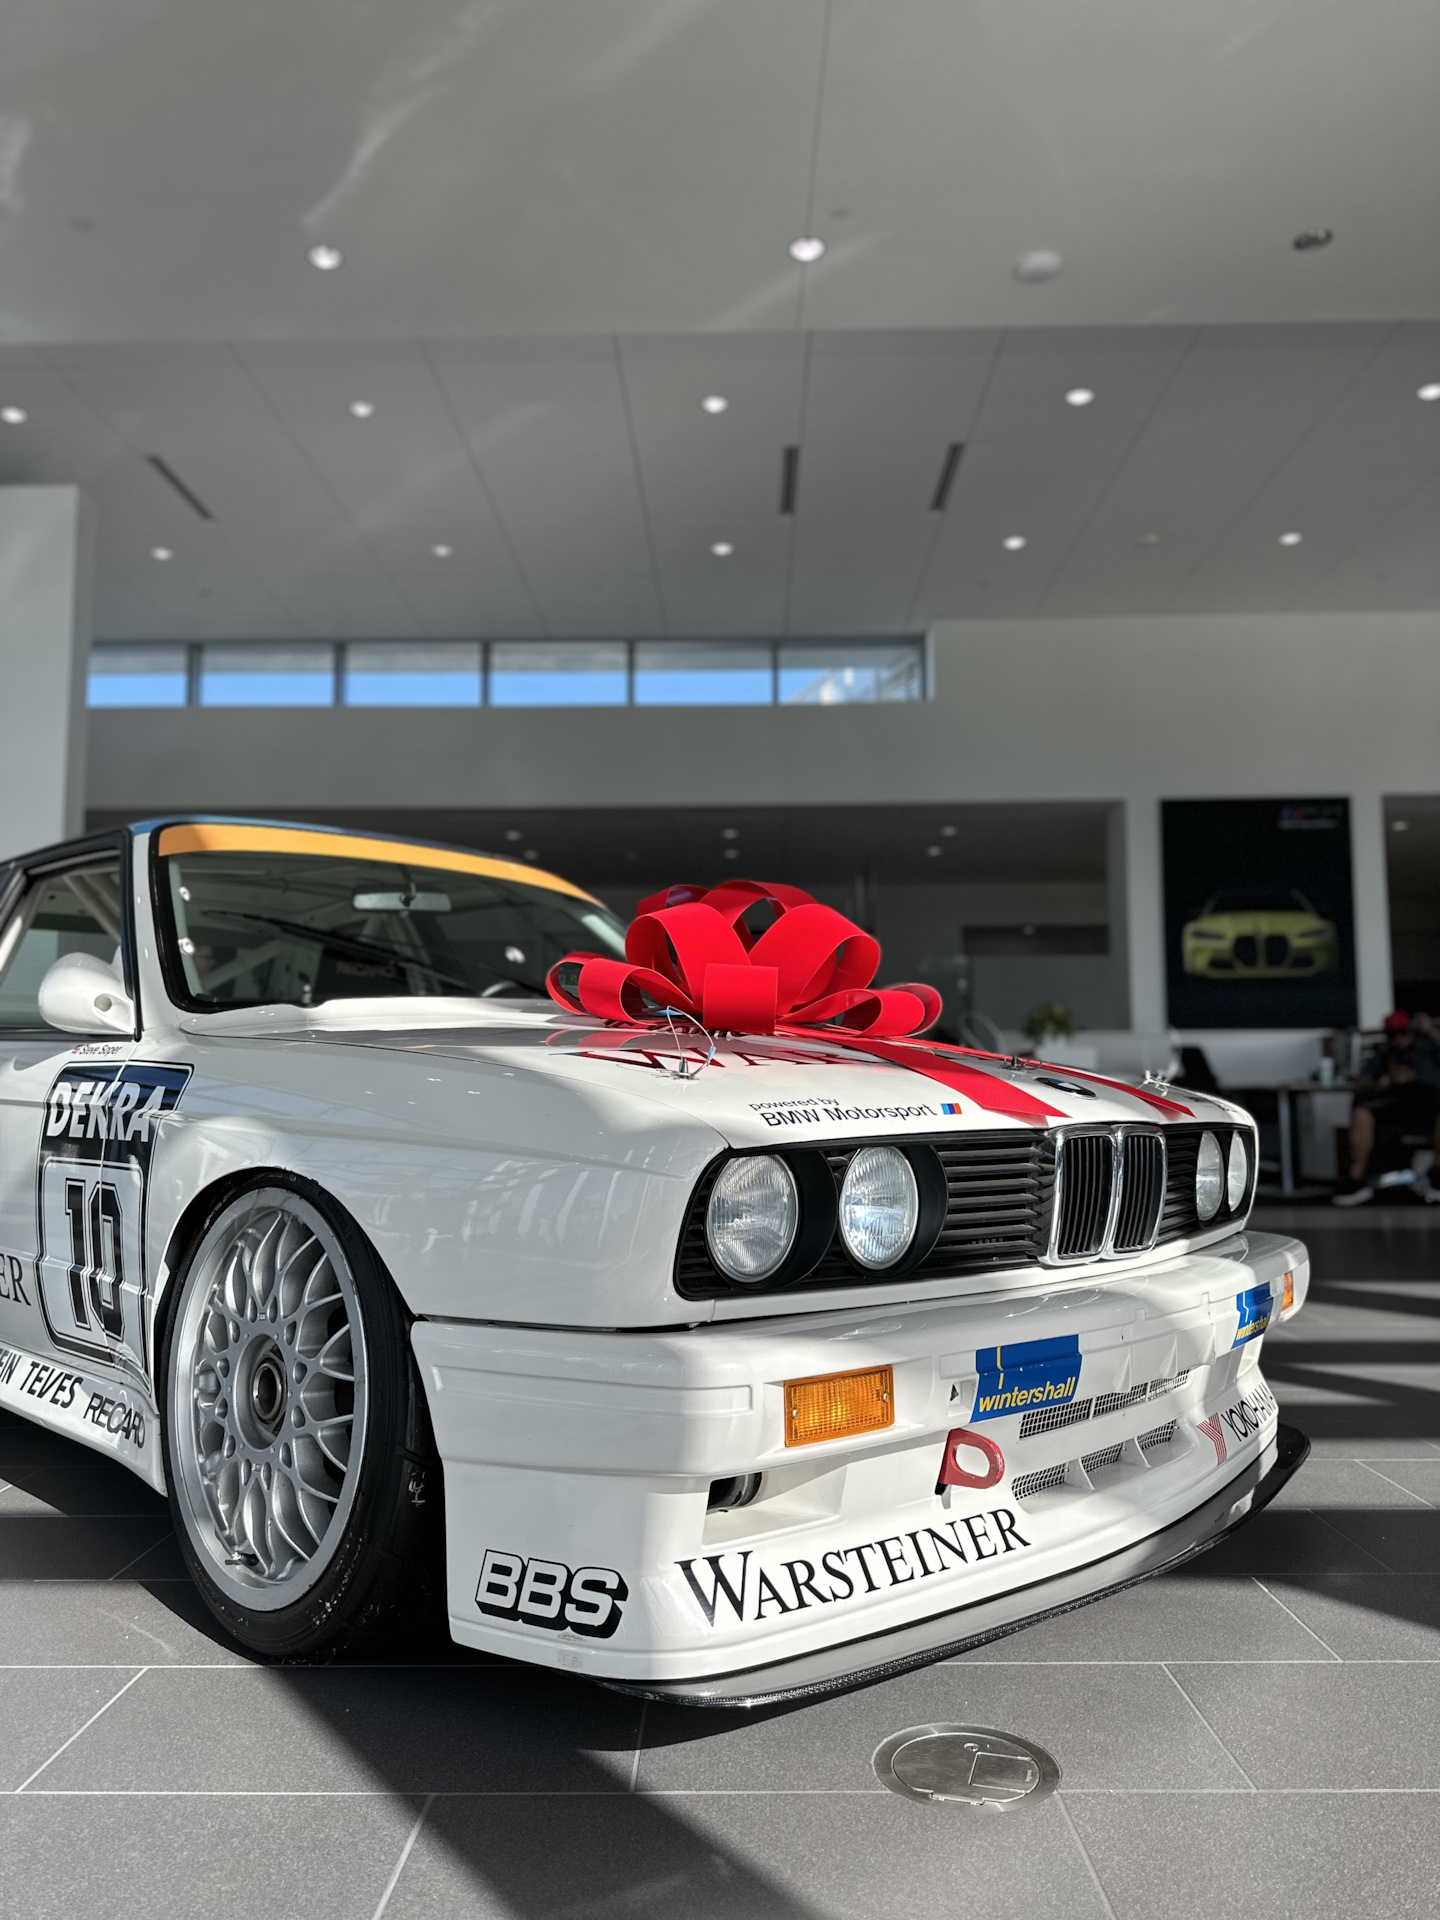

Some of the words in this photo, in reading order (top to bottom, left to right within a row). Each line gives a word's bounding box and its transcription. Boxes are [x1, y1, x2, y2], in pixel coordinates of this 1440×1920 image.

[46, 1081, 166, 1143] DEKRA
[749, 1098, 820, 1111] powered
[817, 1097, 839, 1106] by
[759, 1107, 822, 1127] BMW
[822, 1103, 938, 1121] Motorsport
[65, 1178, 125, 1342] 10
[1235, 1311, 1272, 1341] wintershall
[19, 1361, 84, 1409] TEVES
[83, 1391, 146, 1449] RECARO
[979, 1376, 1076, 1413] wintershall
[475, 1548, 629, 1639] BBS
[673, 1508, 1032, 1627] WARSTEINER
